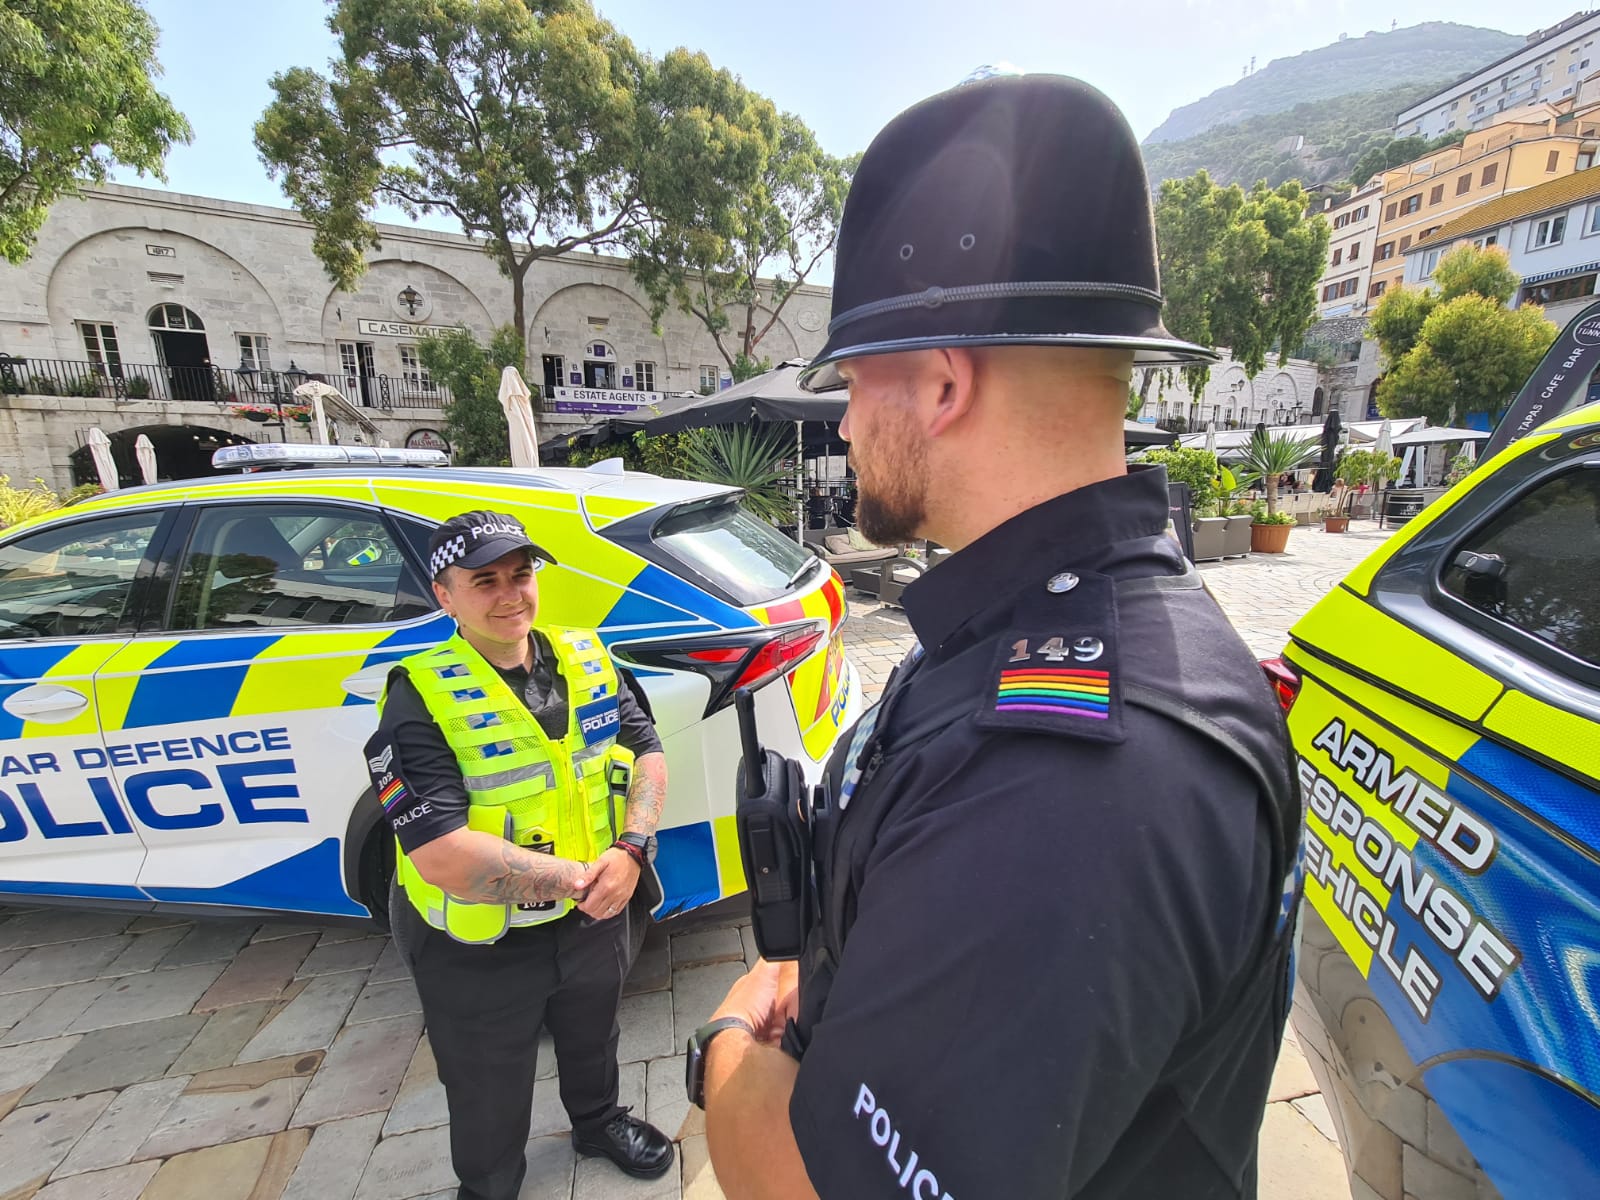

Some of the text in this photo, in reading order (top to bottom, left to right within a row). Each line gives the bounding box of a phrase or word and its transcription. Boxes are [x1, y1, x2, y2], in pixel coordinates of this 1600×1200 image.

[368, 322, 459, 339] CASEMATES
[1577, 328, 1600, 338] TUNN
[573, 390, 647, 402] ESTATE AGENTS
[1517, 403, 1543, 431] TAPAS
[1541, 374, 1565, 399] CAFE
[1563, 347, 1585, 369] BAR
[471, 522, 526, 540] POLICE
[1008, 636, 1104, 663] 149
[582, 711, 619, 734] POLICE
[73, 728, 292, 770] DEFENCE
[377, 771, 394, 791] 102
[1313, 718, 1497, 872] ARMED
[392, 801, 433, 830] POLICE
[1297, 757, 1517, 997] ESPONSE
[1304, 827, 1441, 1019] EHICLE
